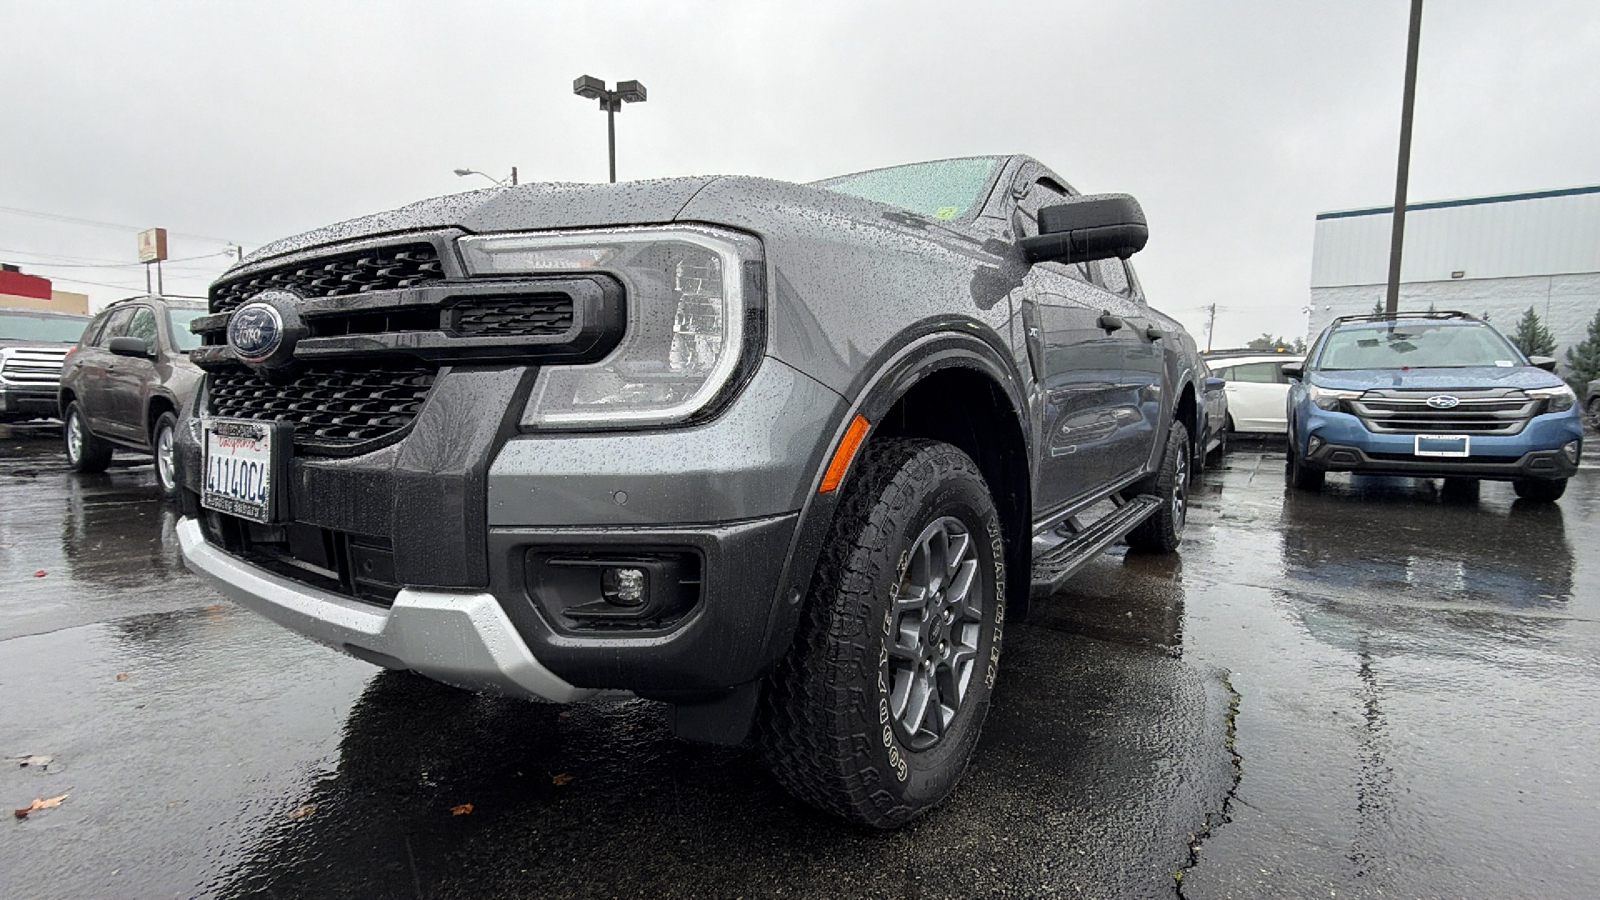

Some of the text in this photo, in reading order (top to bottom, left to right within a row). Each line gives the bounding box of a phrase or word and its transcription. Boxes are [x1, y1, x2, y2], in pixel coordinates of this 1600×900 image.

[235, 314, 265, 345] Ford
[208, 456, 266, 503] 41140C4
[986, 517, 1005, 690] WRANGLER
